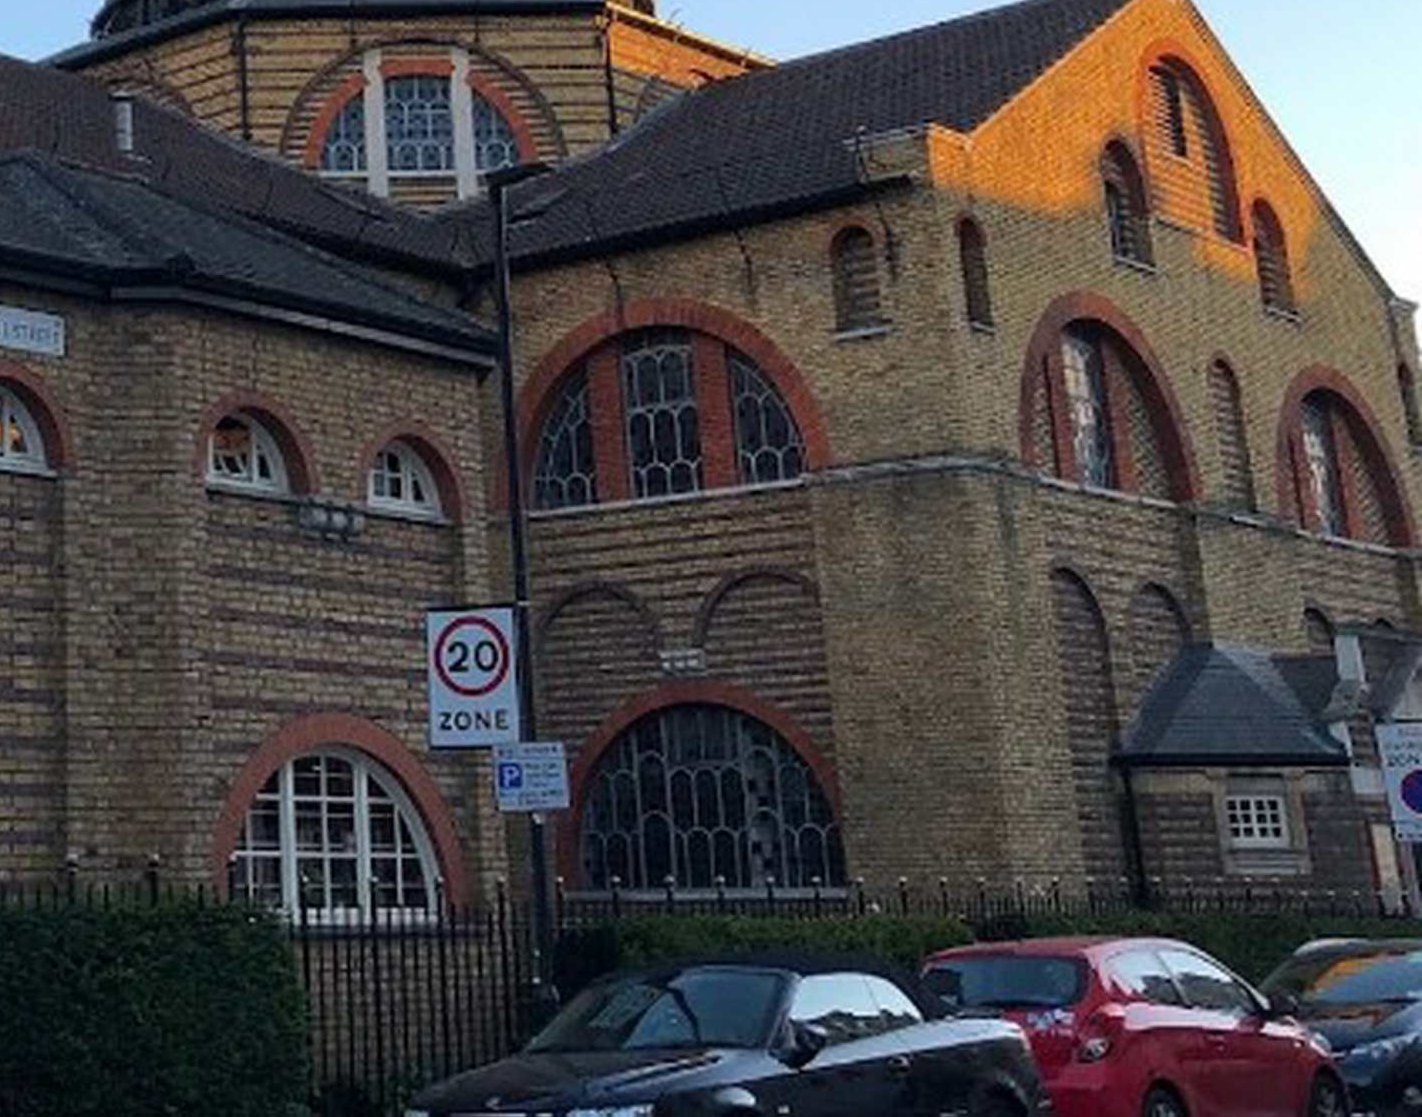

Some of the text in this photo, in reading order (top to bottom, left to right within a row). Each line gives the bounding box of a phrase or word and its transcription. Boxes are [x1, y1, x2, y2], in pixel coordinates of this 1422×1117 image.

[448, 641, 499, 673] 20
[439, 709, 510, 731] ZONE
[502, 766, 520, 788] P
